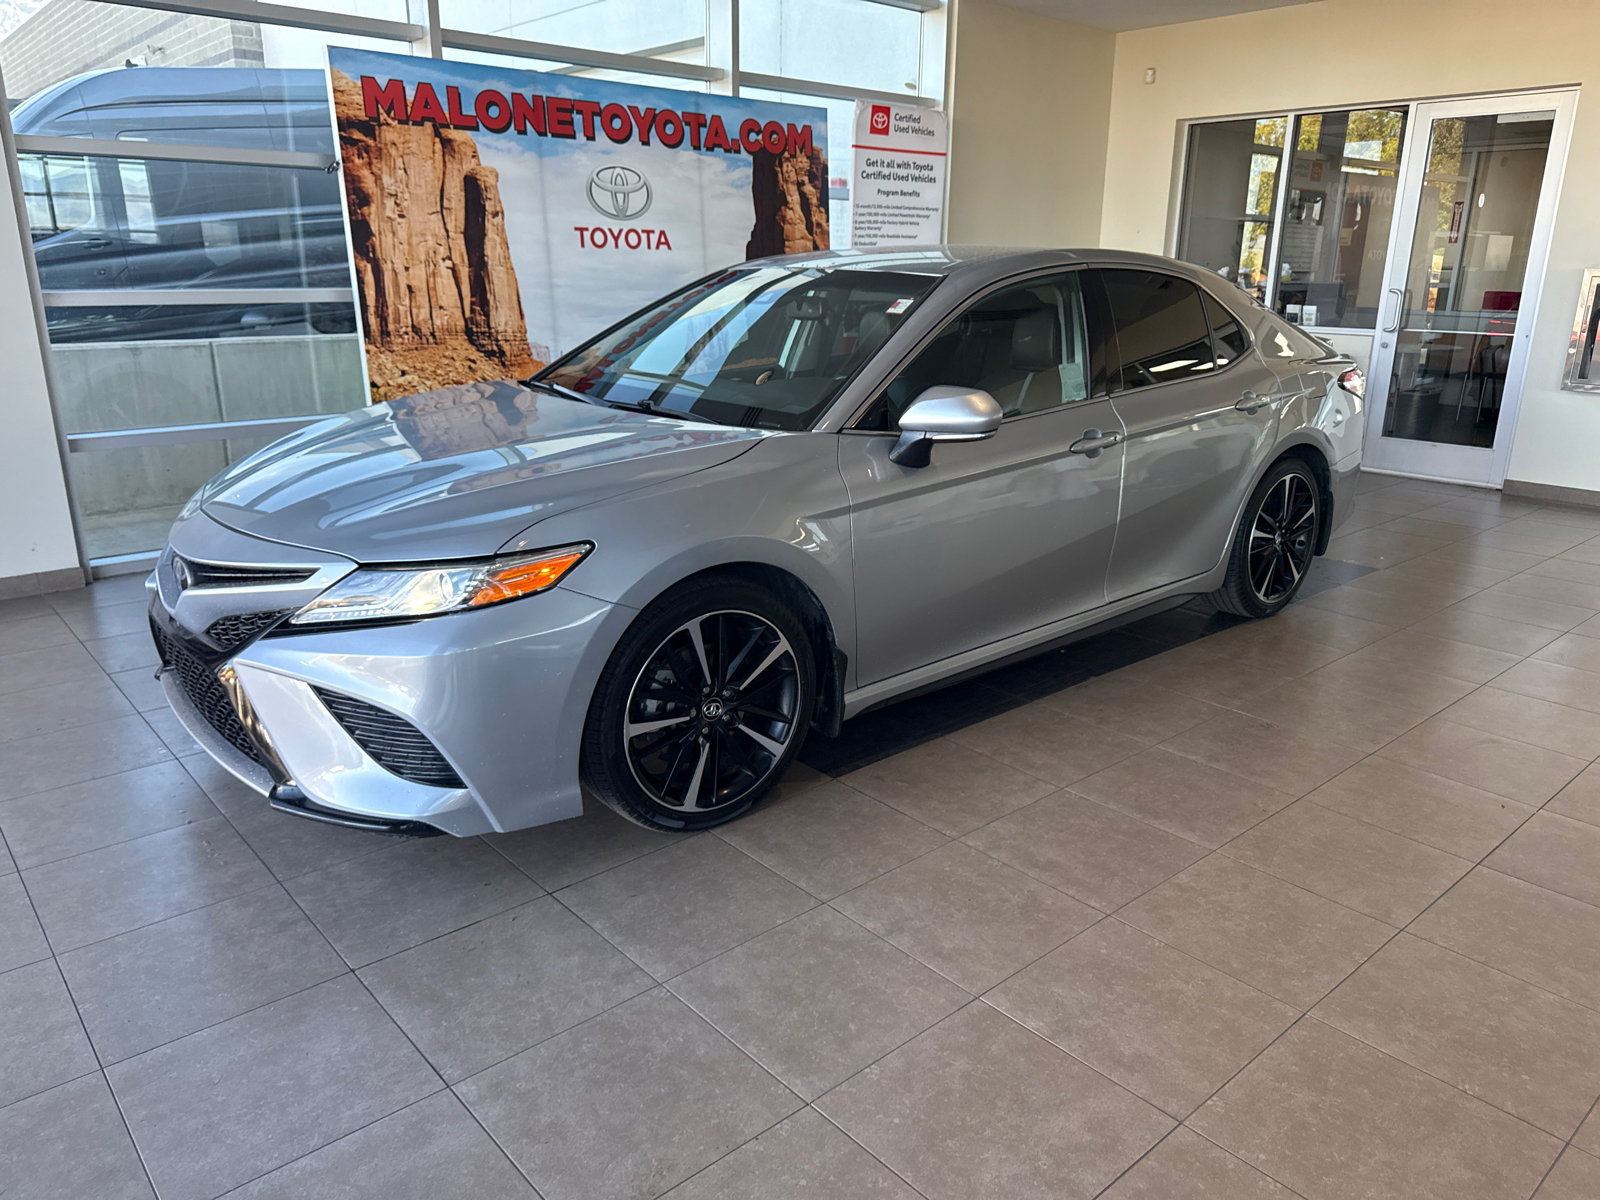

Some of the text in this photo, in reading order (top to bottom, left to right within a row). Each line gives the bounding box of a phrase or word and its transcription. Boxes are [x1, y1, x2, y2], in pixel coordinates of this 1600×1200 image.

[360, 75, 813, 157] MALONETOYOTA.COM
[894, 113, 921, 124] Certified
[894, 124, 935, 137] Used Vehicles
[865, 158, 934, 173] Get it all with Toyota
[861, 170, 936, 184] Certified Used Vehicles
[877, 188, 920, 198] Program Benefits
[573, 226, 672, 251] TOYOTA
